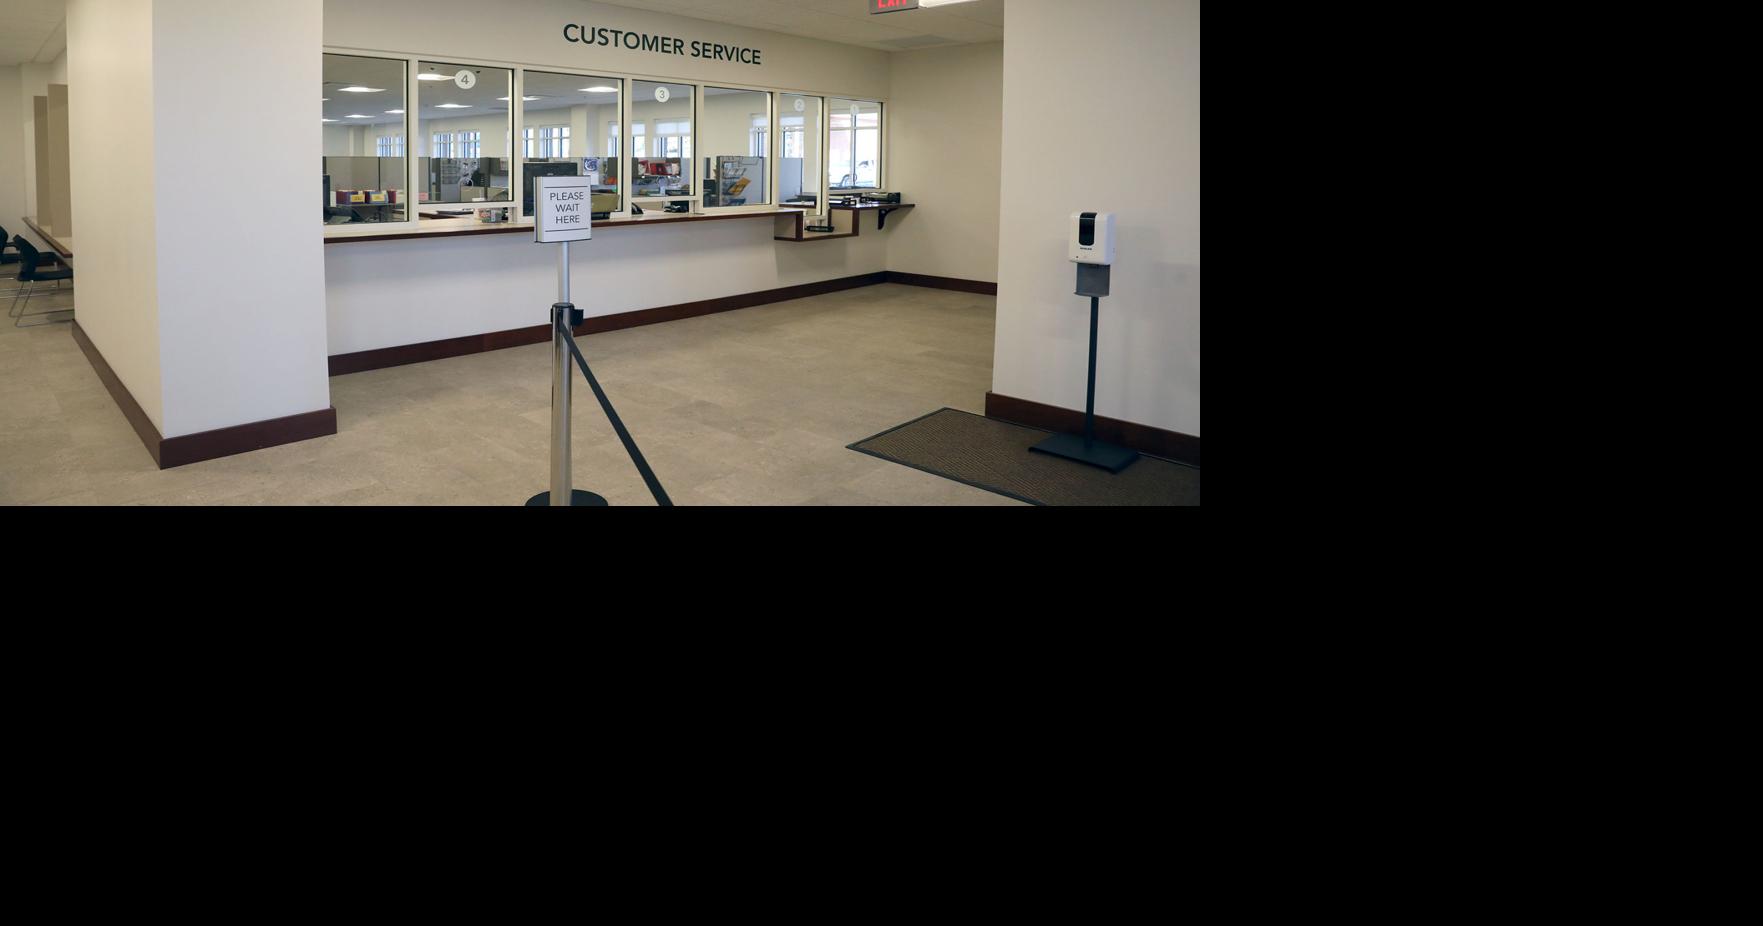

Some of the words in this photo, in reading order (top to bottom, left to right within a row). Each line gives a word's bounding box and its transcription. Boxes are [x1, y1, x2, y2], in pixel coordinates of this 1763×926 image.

[563, 23, 684, 55] CUSTOMER
[690, 41, 761, 64] SERVICE
[460, 74, 470, 84] 4
[549, 192, 584, 200] PLEASE
[555, 204, 580, 212] WAIT
[556, 214, 580, 224] HERE
